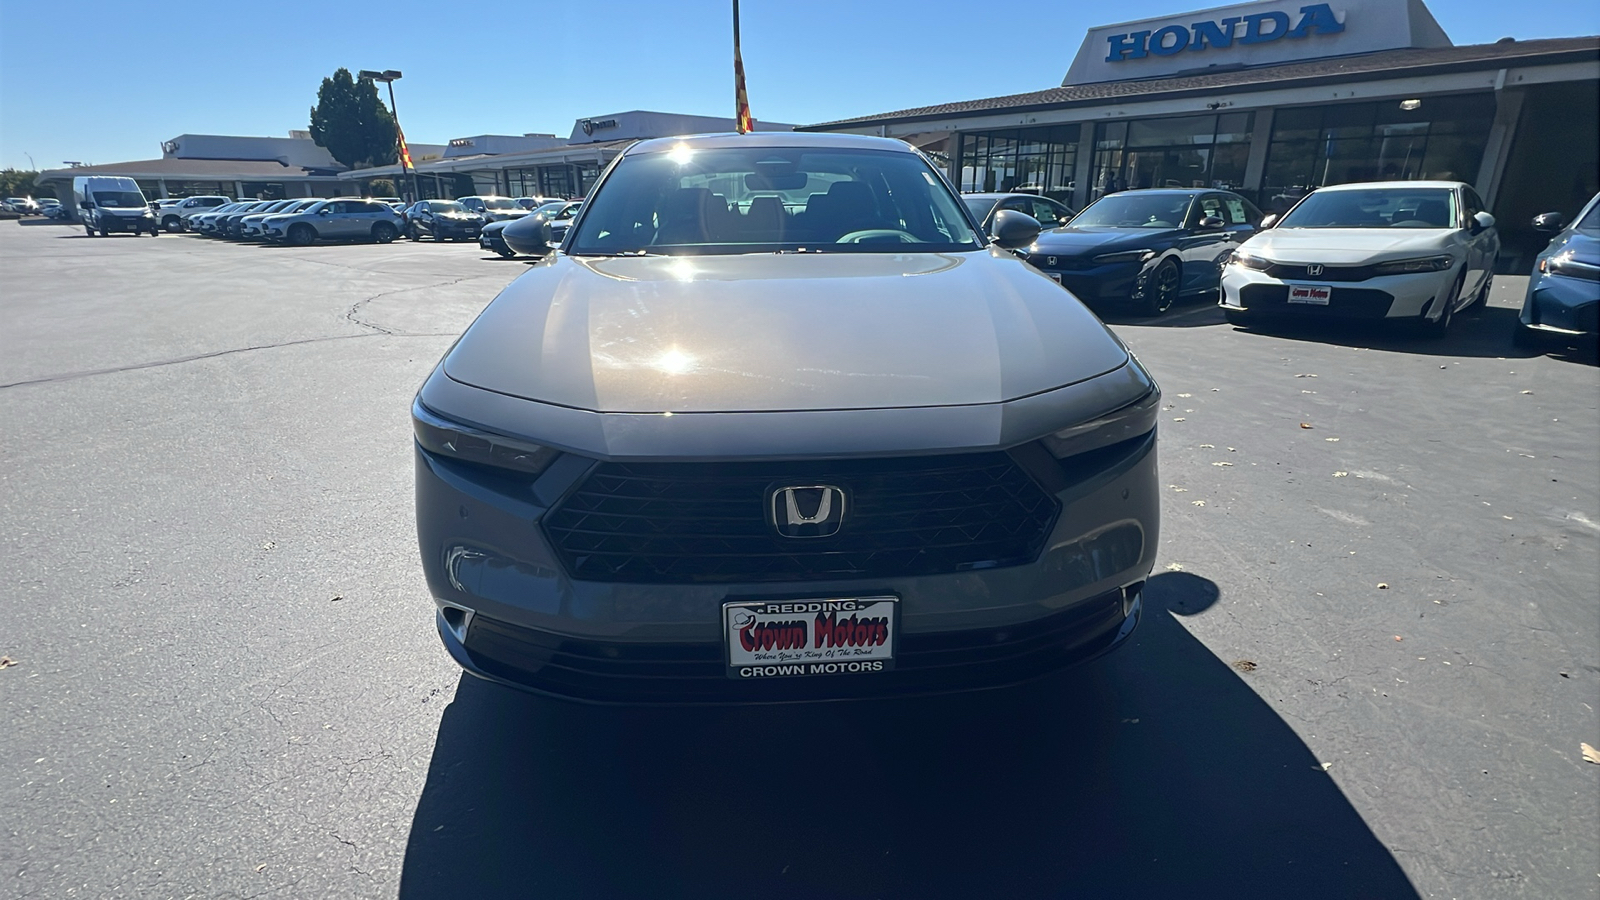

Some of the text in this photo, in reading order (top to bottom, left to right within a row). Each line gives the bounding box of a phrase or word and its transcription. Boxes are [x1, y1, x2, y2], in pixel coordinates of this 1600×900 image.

[1104, 2, 1346, 63] HONDA
[767, 601, 857, 614] REDDING
[739, 611, 889, 652] Crown Motors
[754, 653, 777, 661] Where
[804, 650, 823, 659] King
[825, 649, 836, 658] Of
[837, 648, 850, 656] The
[853, 648, 873, 656] Road
[740, 660, 883, 677] CROWN MOTORS
